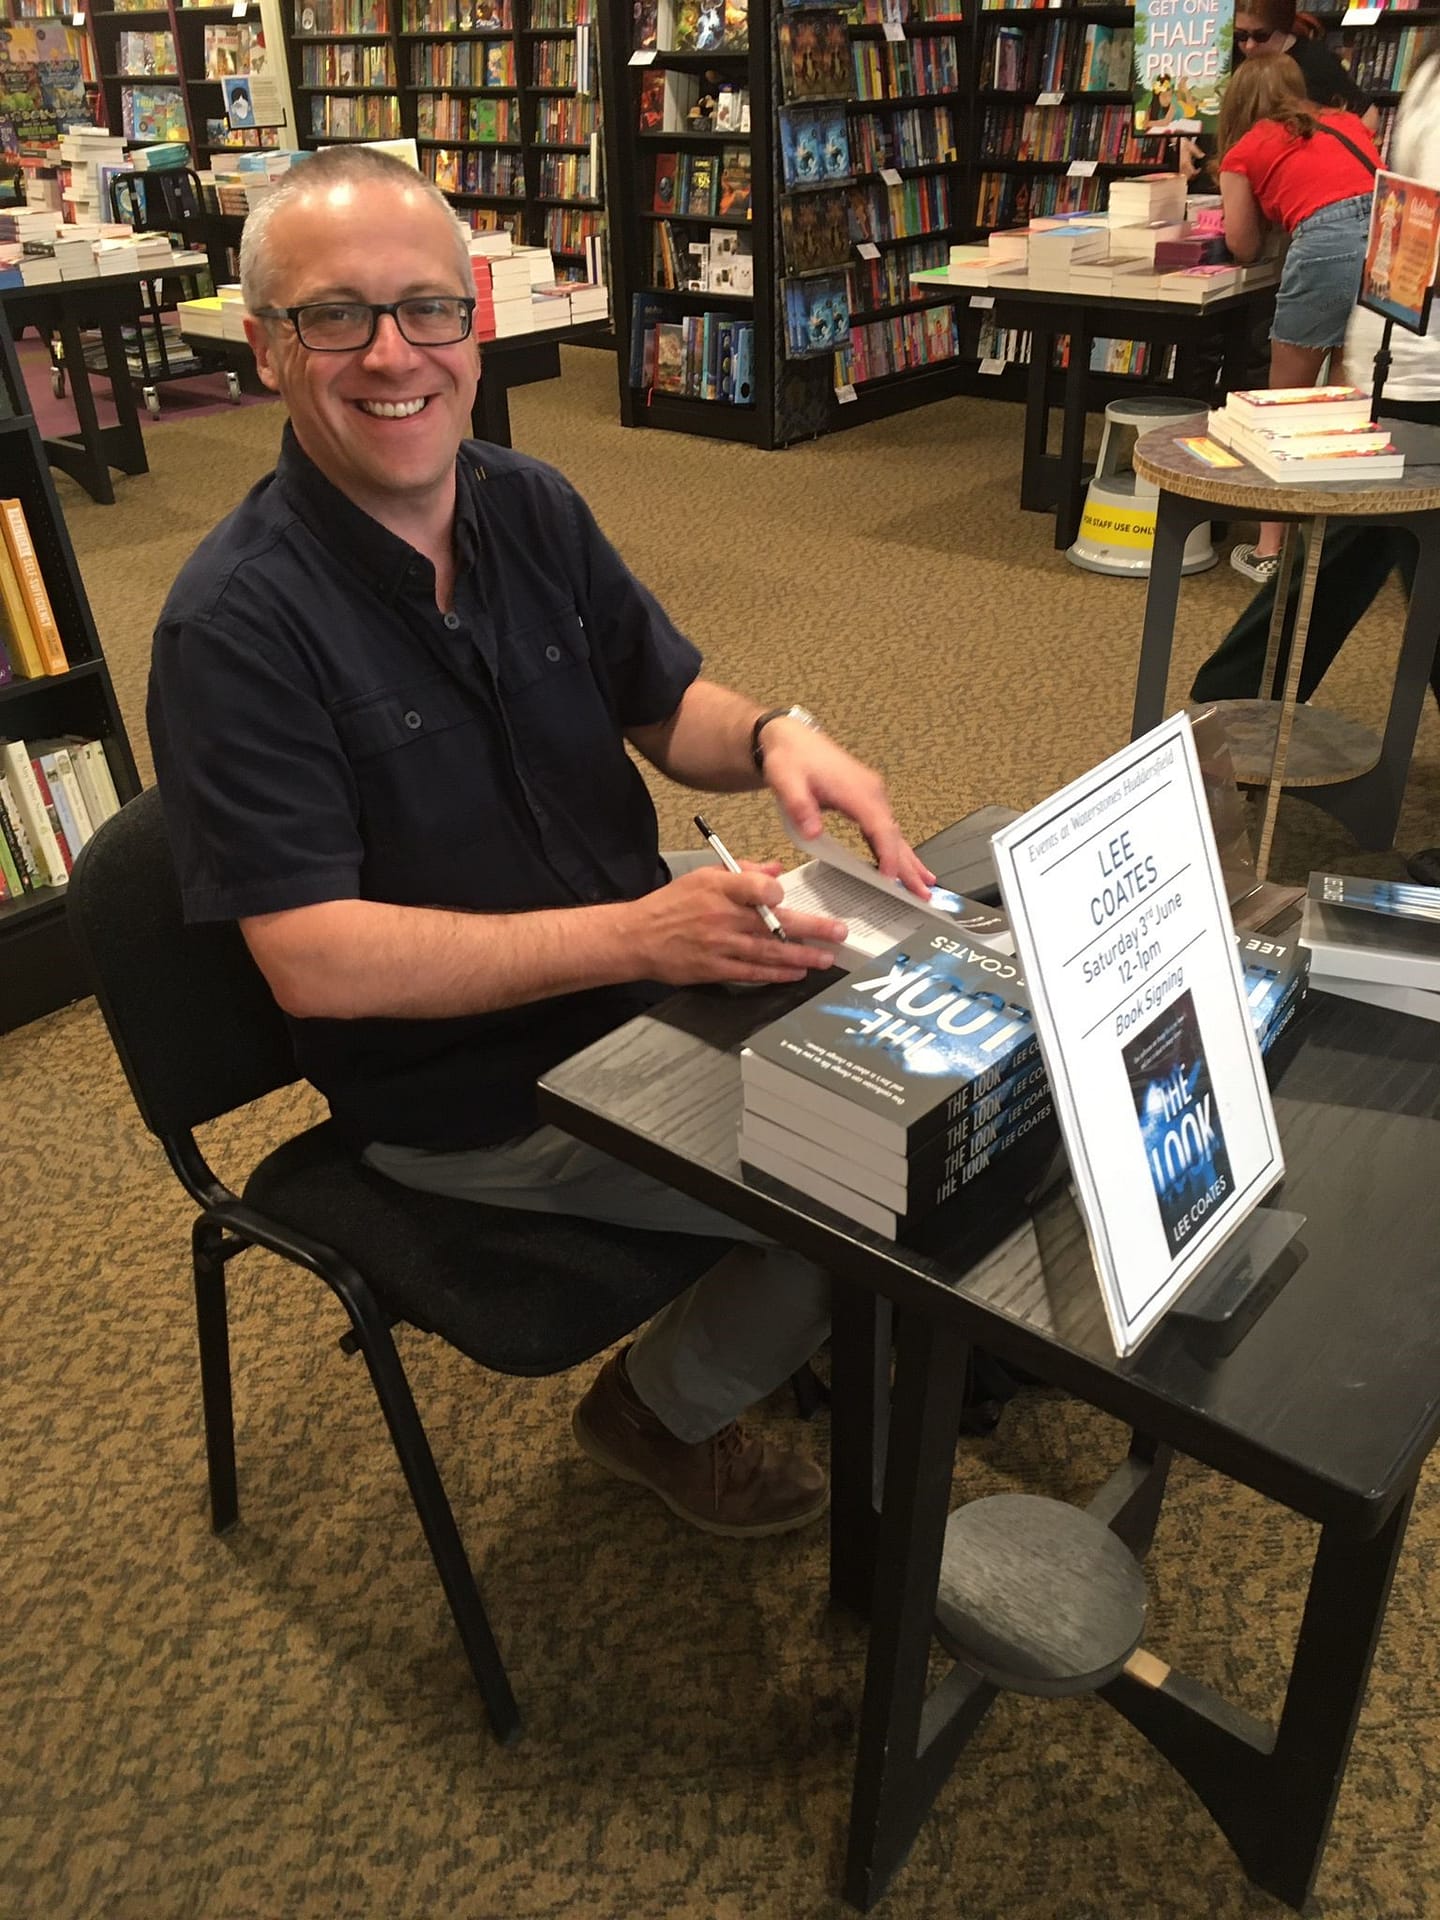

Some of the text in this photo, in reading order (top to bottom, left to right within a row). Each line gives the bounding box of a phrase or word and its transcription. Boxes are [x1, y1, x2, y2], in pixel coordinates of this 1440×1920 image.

[1148, 0, 1219, 16] GET ONE
[1150, 19, 1216, 49] HALF
[1147, 48, 1219, 80] PRICE
[1093, 518, 1113, 529] STAFF
[1114, 522, 1131, 533] USE
[1028, 750, 1174, 863] Events at Waterstones Huddersfield
[1097, 830, 1135, 878] LEE
[1090, 855, 1159, 926] COATES
[930, 936, 1017, 976] COATES
[1082, 931, 1139, 984] Saturday
[1154, 892, 1183, 926] June
[1117, 940, 1162, 985] 12-1pm
[1246, 939, 1287, 957] LEE
[1115, 965, 1185, 1038] Book Signing
[946, 1080, 1028, 1150] THE LOOK LEE
[947, 1087, 969, 1121] THE
[973, 1064, 1001, 1101] LOOK
[1012, 1050, 1028, 1068] LEE
[1160, 1064, 1193, 1122] THE
[936, 1103, 1052, 1205] THE LOOK LEE COATES
[944, 1146, 966, 1179] THE
[970, 1124, 997, 1157] LOOK
[1008, 1106, 1022, 1124] LEE
[1151, 1093, 1216, 1193] LOOK
[1172, 1174, 1227, 1242] LEE COATES
